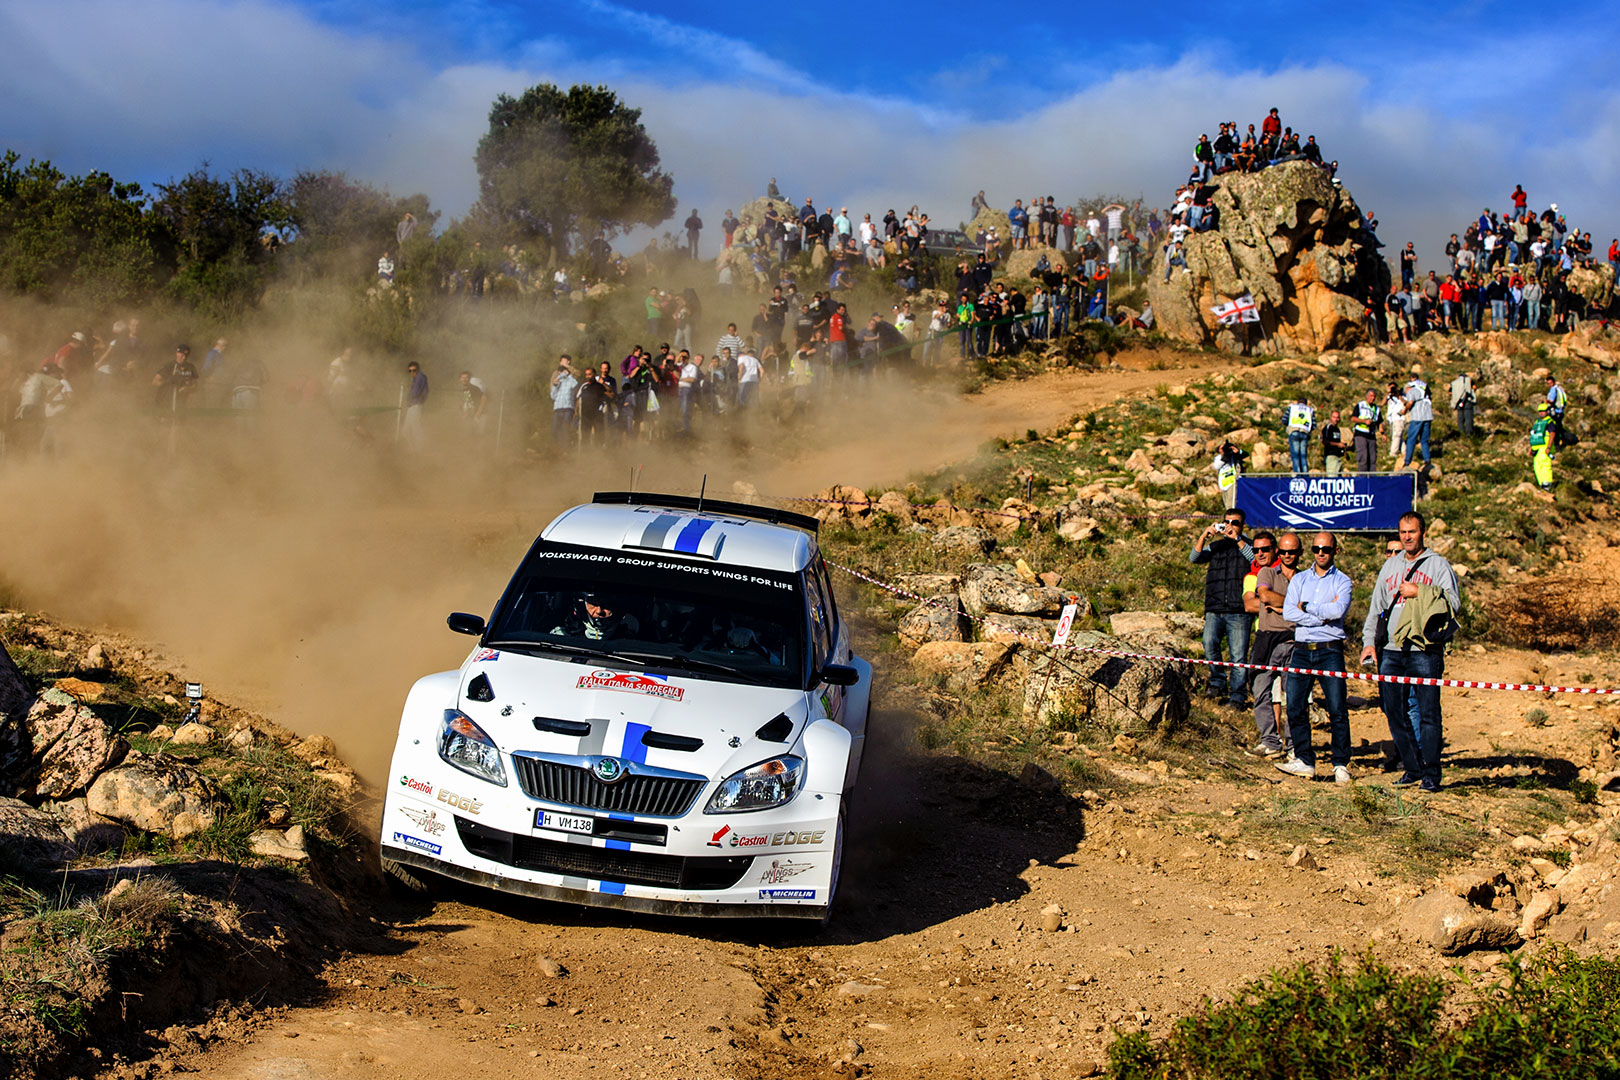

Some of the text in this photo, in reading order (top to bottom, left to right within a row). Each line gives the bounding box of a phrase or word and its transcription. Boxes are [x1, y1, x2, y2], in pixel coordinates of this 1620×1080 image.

[1308, 479, 1355, 494] ACTION
[1289, 494, 1374, 507] FOR ROAD SAFETY
[539, 552, 793, 591] VOLKSWAGEN GROUP SUPPORTS WINGS FOR LIFE
[582, 676, 608, 685] RALLY
[608, 680, 634, 689] ITALIA
[636, 683, 680, 697] SARDEGNA
[408, 778, 484, 815] Castrol EDGE
[544, 814, 551, 825] H
[406, 837, 440, 852] MICHELIN
[739, 830, 826, 847] Castrol EDGE
